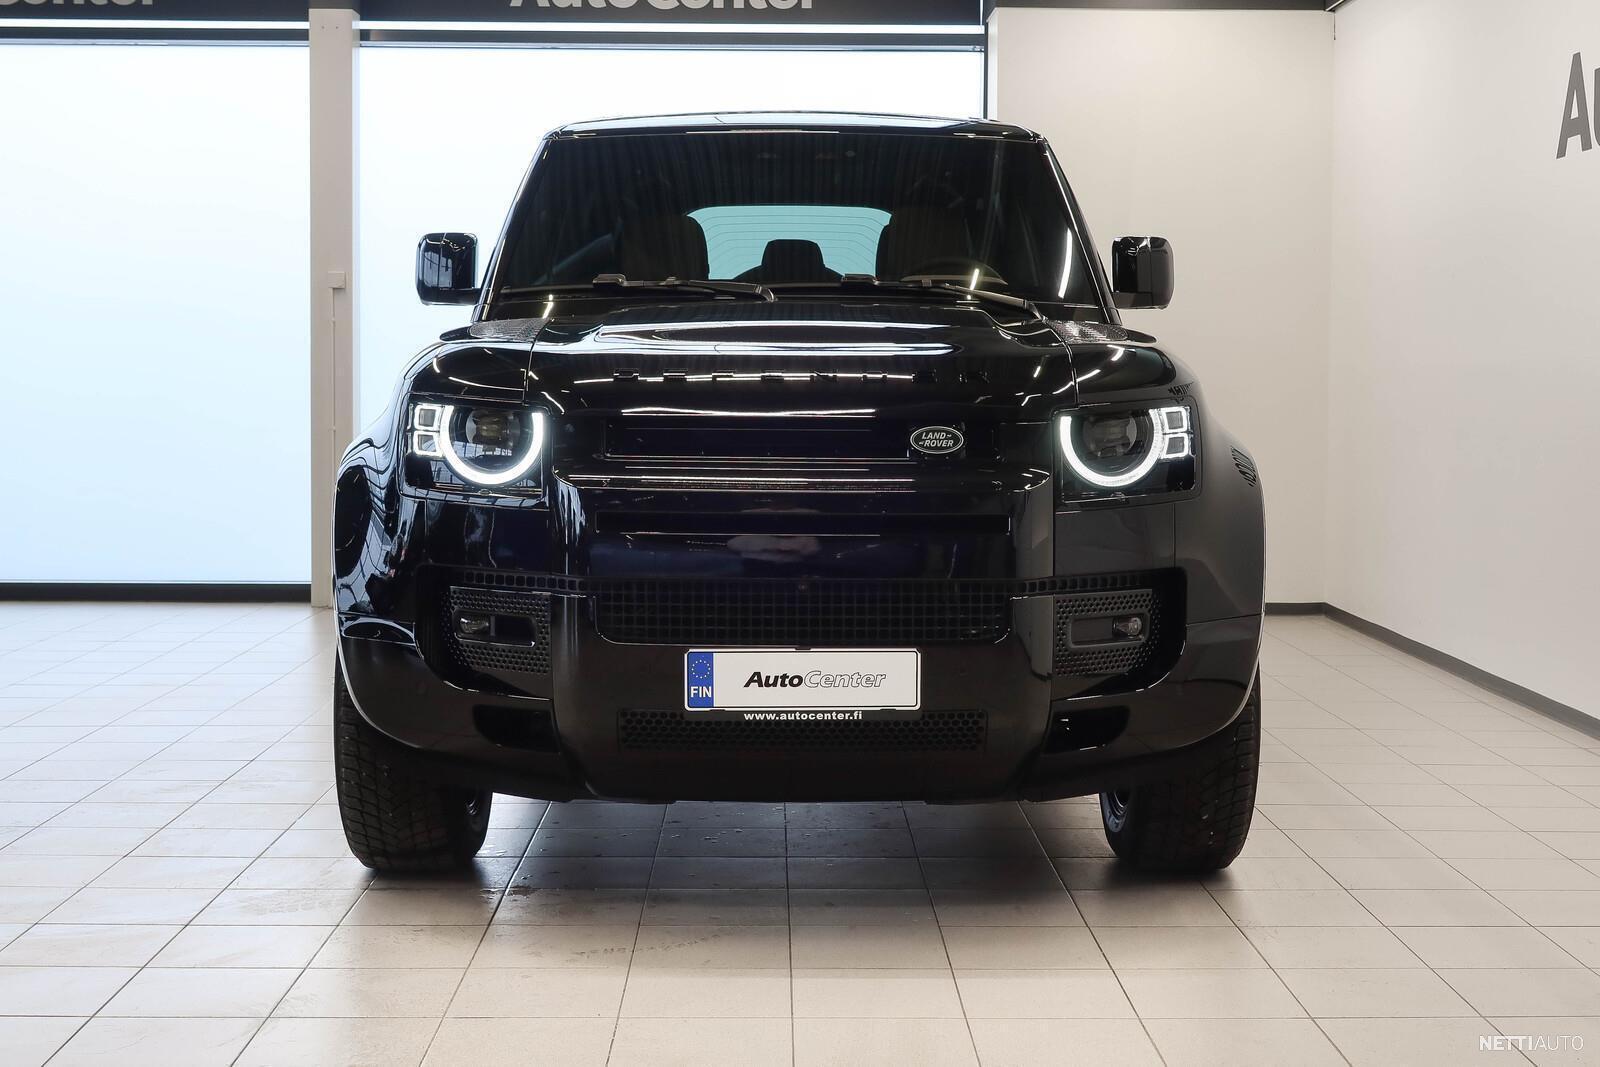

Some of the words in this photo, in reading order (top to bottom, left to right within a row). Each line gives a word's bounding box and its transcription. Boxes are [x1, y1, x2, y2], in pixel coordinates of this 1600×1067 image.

[1556, 51, 1600, 159] A
[922, 432, 946, 440] LAND
[743, 670, 886, 688] AutoCenter
[690, 686, 712, 698] FIN
[743, 711, 863, 720] www.autocenter.fi
